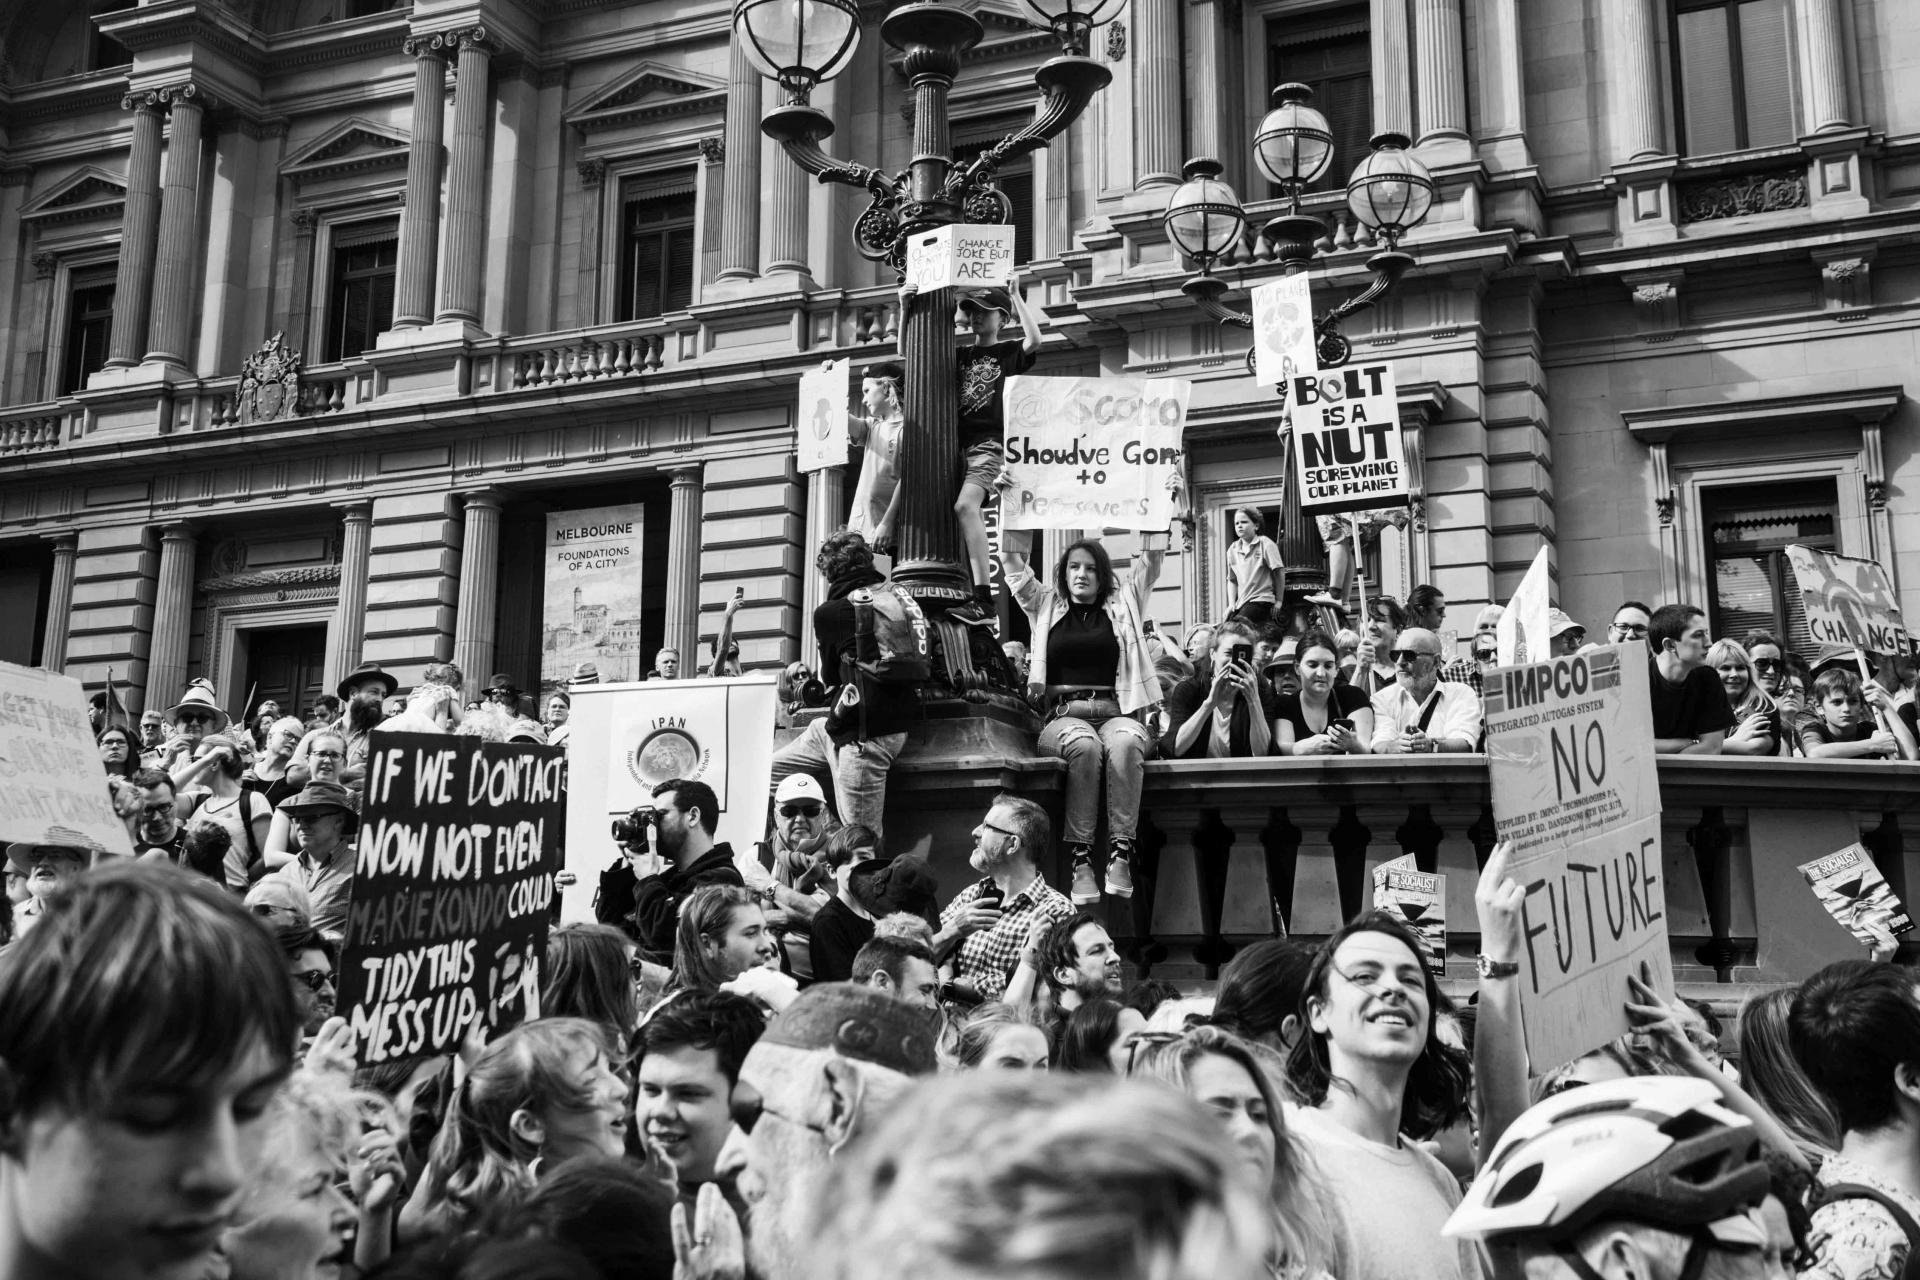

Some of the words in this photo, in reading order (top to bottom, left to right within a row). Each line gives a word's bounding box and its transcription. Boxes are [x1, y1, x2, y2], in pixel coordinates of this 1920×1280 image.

[956, 248, 985, 259] JOKE
[990, 249, 1010, 260] BUT
[958, 239, 1003, 249] CHANGE
[957, 262, 996, 279] ARE
[1294, 366, 1387, 407] BOLT
[1351, 403, 1367, 424] A
[1301, 422, 1394, 469] NUT
[1076, 469, 1107, 485] to
[1308, 484, 1340, 499] OUR
[1342, 477, 1398, 495] PLANET
[556, 522, 633, 541] MELBOURNE
[557, 546, 630, 562] FOUNDATIONS
[568, 561, 582, 572] OF
[585, 561, 593, 570] A
[595, 558, 618, 569] CITY
[894, 586, 928, 656] adidas
[1505, 656, 1589, 711] IMPCO
[651, 716, 686, 730] IPAN
[1486, 713, 1540, 736] INTEGRATED
[1541, 704, 1576, 723] AUTOGAS
[1577, 698, 1604, 716] SYSTEM
[1550, 719, 1606, 807] NO
[370, 748, 404, 807] IF
[414, 748, 457, 808] WE
[530, 756, 564, 805] ACT
[1540, 806, 1560, 819] IMPCO
[356, 816, 429, 880] NOW
[431, 823, 492, 883] NOT
[494, 817, 545, 875] EVEN
[1819, 849, 1857, 874] SOCIALIST
[1400, 874, 1435, 890] SOCIALIST
[350, 888, 433, 946] MARIE
[430, 883, 509, 940] KONDO
[508, 872, 553, 919] COULD
[1522, 837, 1662, 994] FUTURE
[361, 946, 427, 1005] TIDY
[427, 938, 478, 991] THIS
[350, 997, 433, 1063] MESS
[432, 986, 477, 1050] UP
